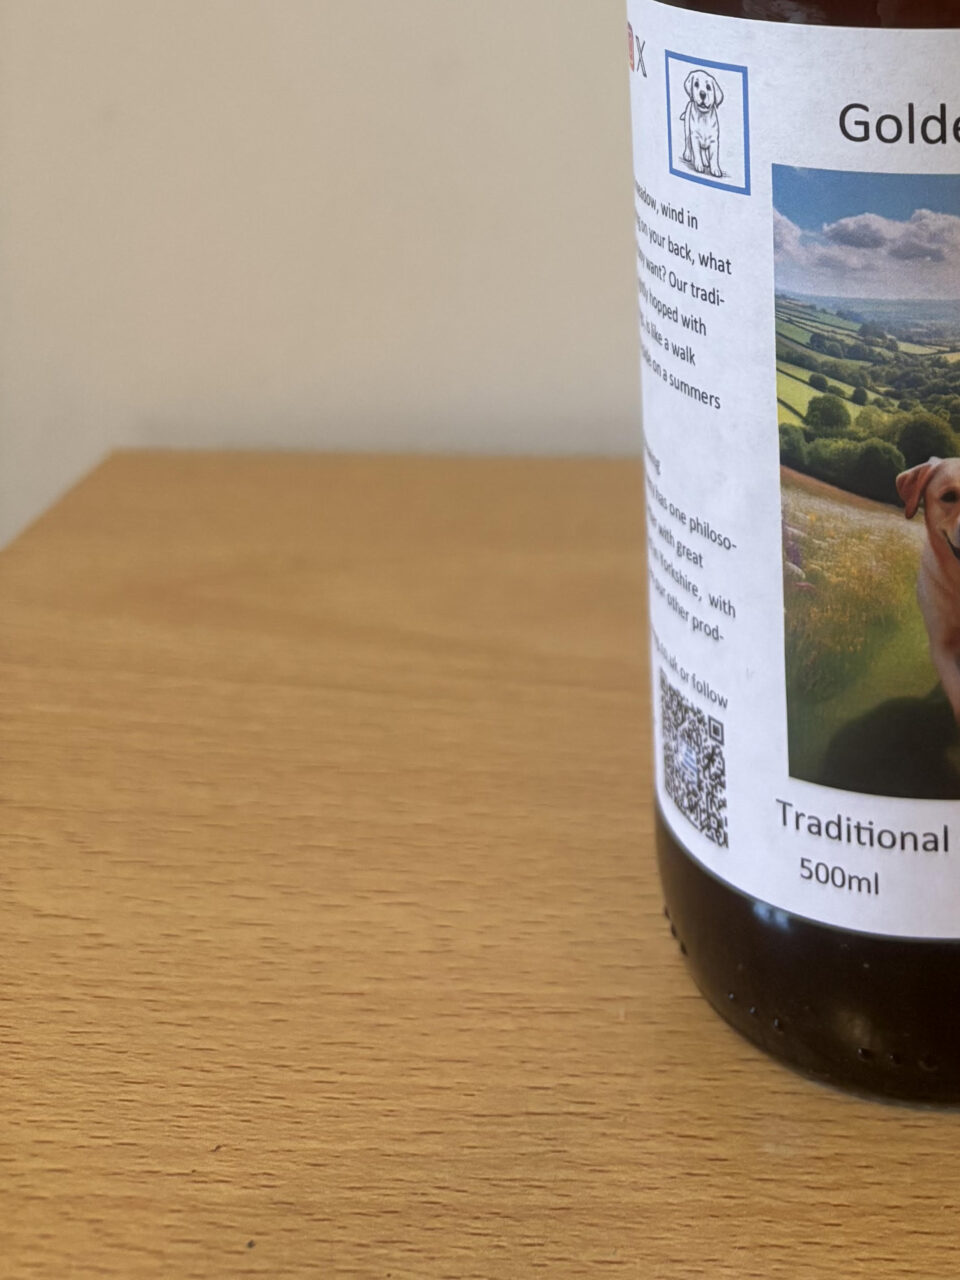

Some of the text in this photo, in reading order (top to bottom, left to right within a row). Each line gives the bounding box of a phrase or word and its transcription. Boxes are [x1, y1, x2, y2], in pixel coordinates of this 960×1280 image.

[661, 201, 684, 225] wind
[687, 211, 698, 230] in
[649, 228, 666, 248] your
[668, 236, 695, 265] back,
[698, 251, 732, 275] what
[645, 258, 666, 282] want?
[669, 271, 687, 294] Our
[691, 281, 725, 307] tradi-
[649, 290, 679, 323] hopped
[681, 314, 707, 337] with
[650, 323, 663, 346] like
[664, 337, 669, 351] a
[671, 342, 696, 367] walk
[652, 360, 721, 410] on a summers
[658, 521, 675, 547] with
[676, 539, 704, 569] great
[669, 501, 687, 525] one
[689, 516, 737, 551] philoso-
[659, 555, 736, 619] Yorkshire, with
[667, 592, 690, 622] other
[692, 615, 725, 642] prod-
[680, 666, 729, 710] or follow
[776, 798, 949, 853] Traditional
[799, 857, 880, 896] 500ml
